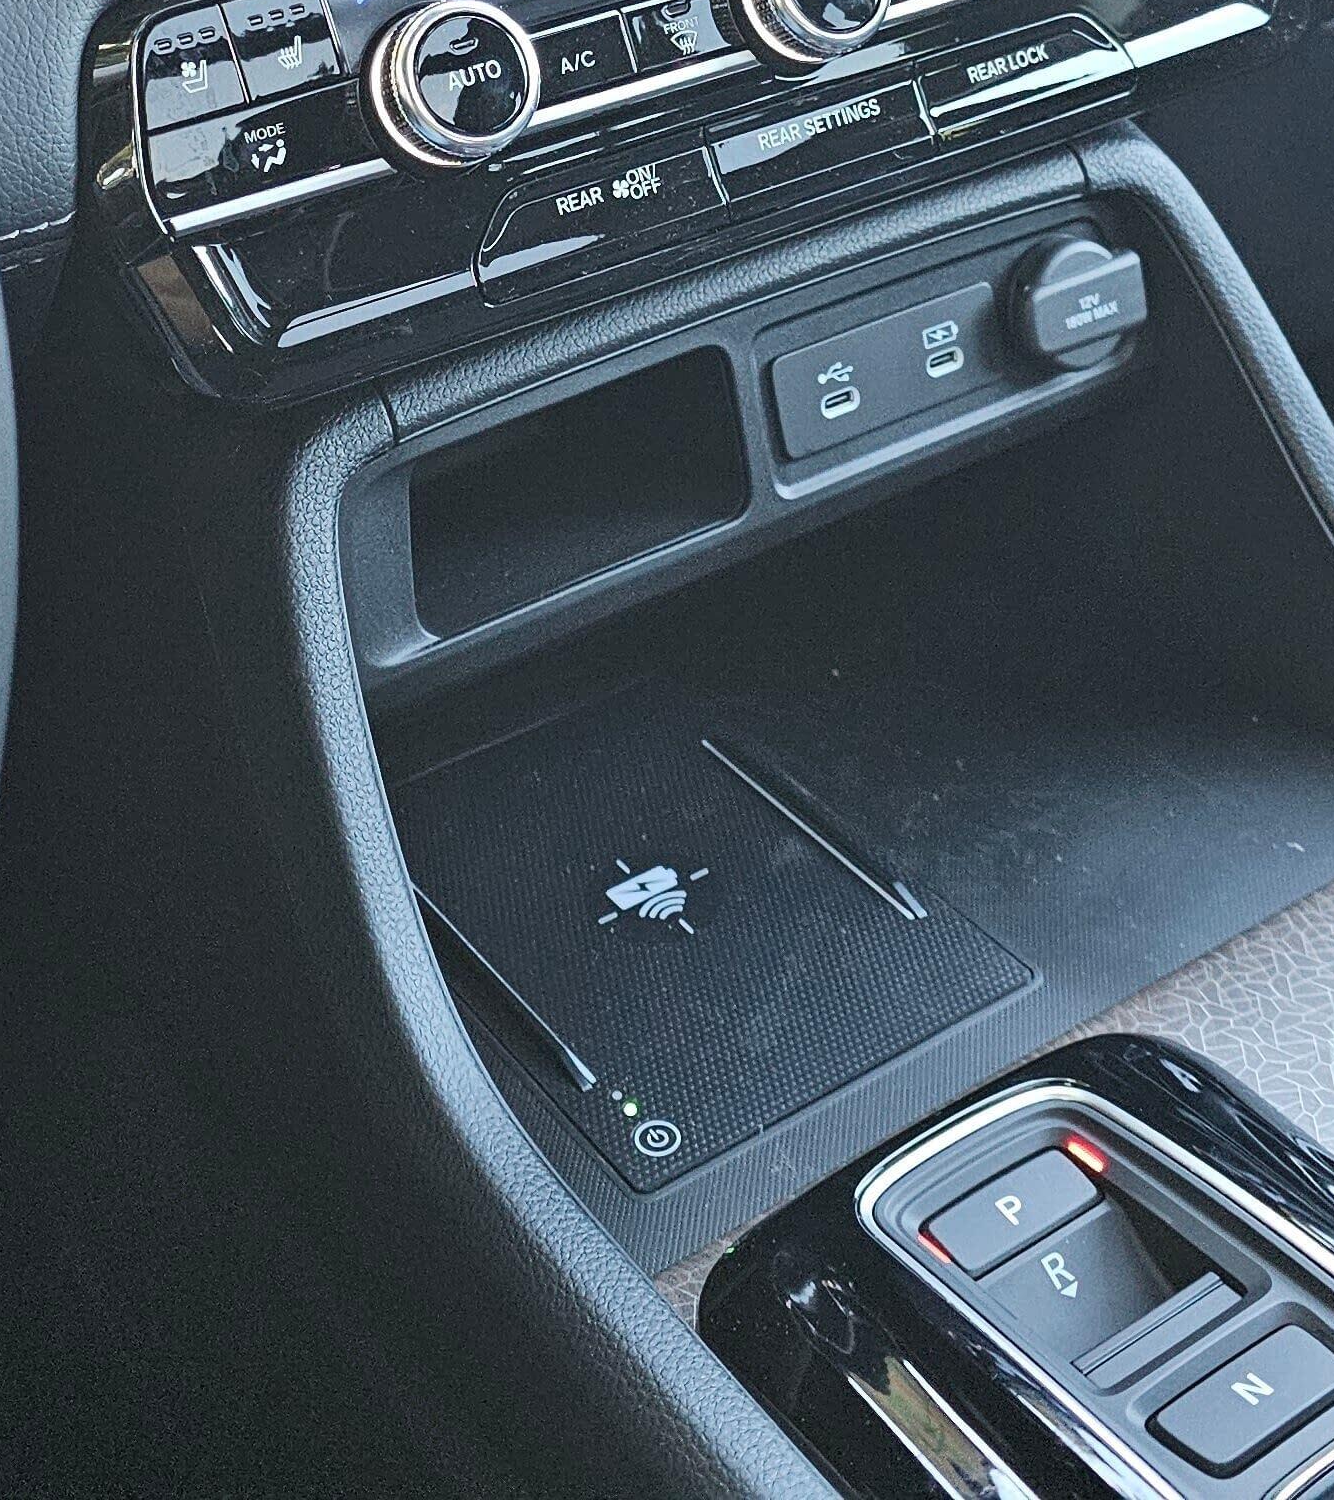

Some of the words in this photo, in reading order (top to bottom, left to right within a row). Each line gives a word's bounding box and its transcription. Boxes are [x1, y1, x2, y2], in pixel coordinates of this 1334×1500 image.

[663, 16, 699, 34] FRONT
[447, 59, 502, 91] AUTO
[559, 50, 597, 76] A/C
[966, 57, 1008, 84] REAR
[1009, 43, 1049, 72] LOCK
[244, 122, 286, 145] MODE
[757, 122, 802, 151] REAR
[804, 98, 881, 136] SETTINGS
[555, 187, 605, 216] REAR
[625, 163, 656, 185] ON/
[630, 177, 662, 200] OFF
[993, 1194, 1024, 1227] P
[1040, 1251, 1071, 1290] R
[1231, 1371, 1276, 1406] N
